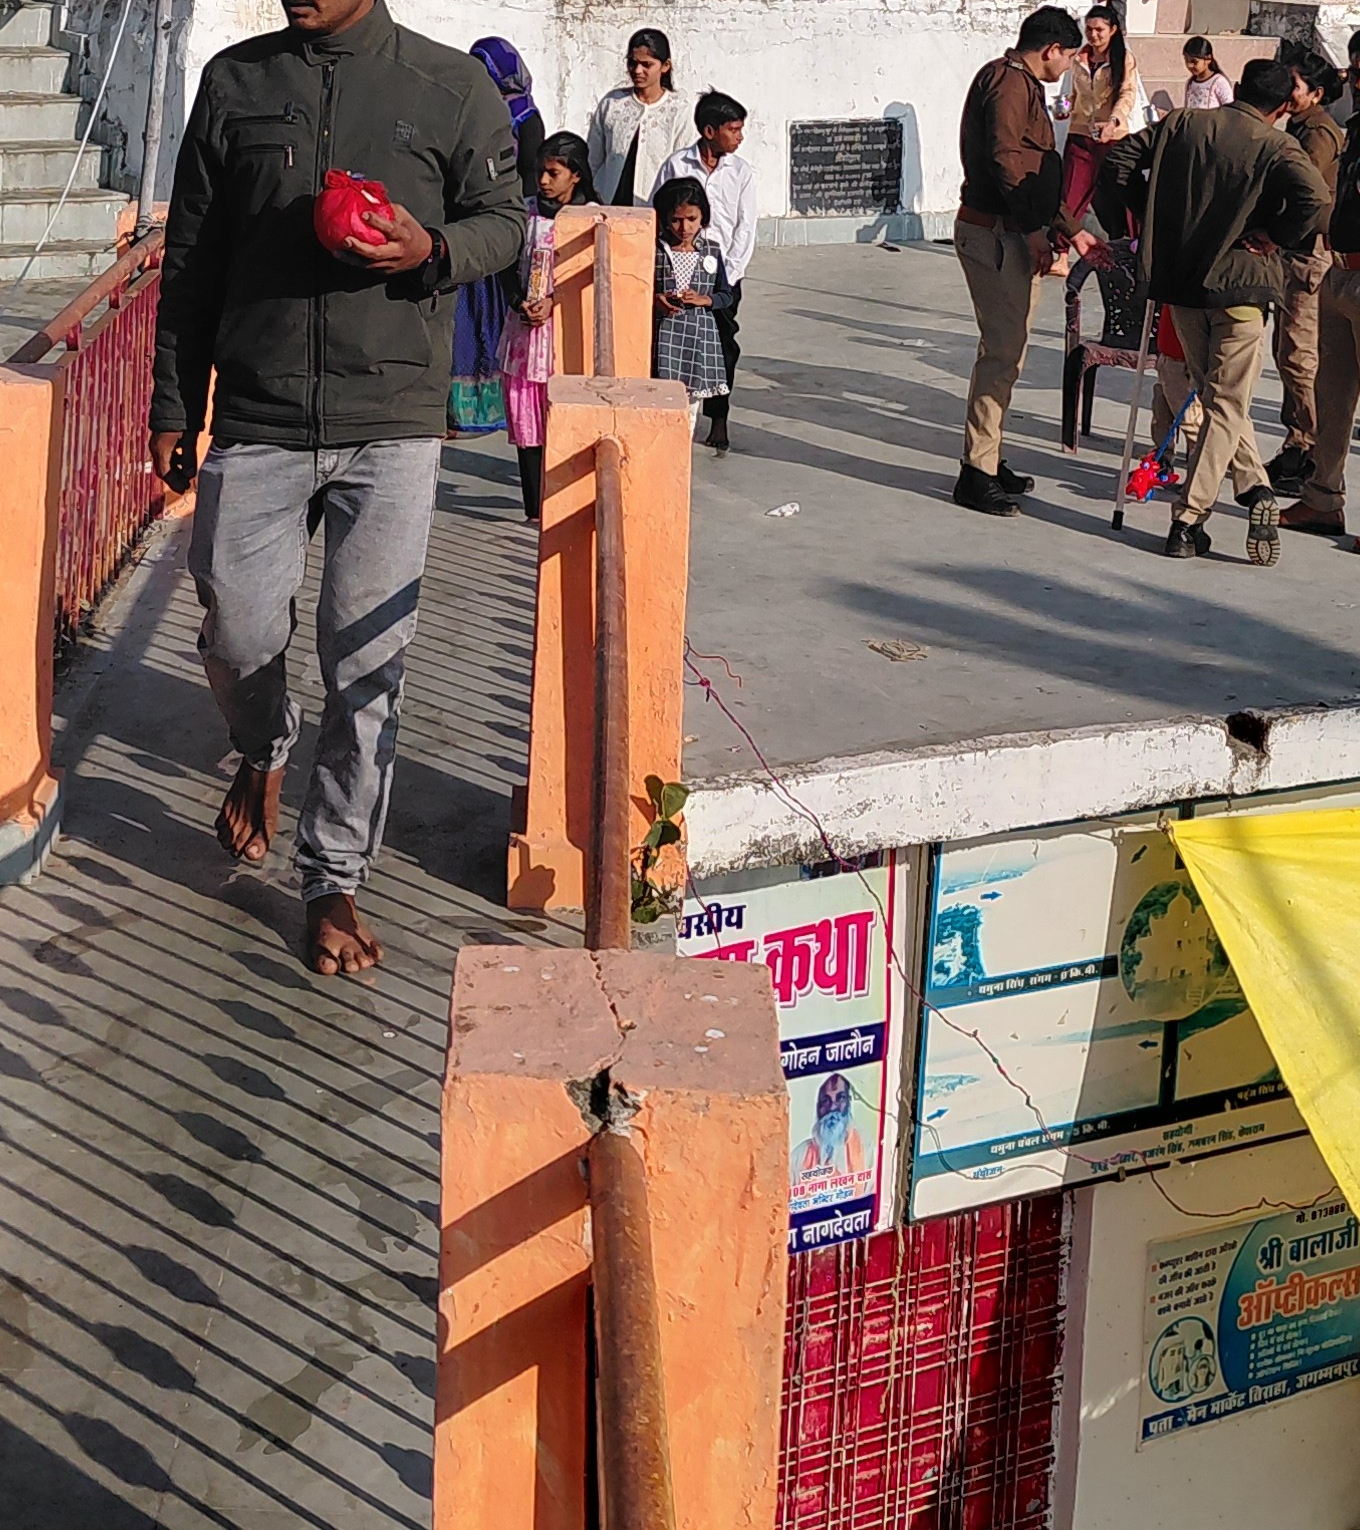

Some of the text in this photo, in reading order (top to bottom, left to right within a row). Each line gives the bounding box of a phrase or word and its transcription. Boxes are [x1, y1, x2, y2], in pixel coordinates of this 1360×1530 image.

[764, 910, 876, 1003] कथा
[825, 1029, 876, 1062] जालौन
[801, 1209, 872, 1245] नागदेवता
[1258, 1216, 1360, 1270] श्री बालाजी
[1148, 1414, 1174, 1436] पता
[1186, 1405, 1208, 1423] मैन
[1210, 1389, 1246, 1416] मार्केट
